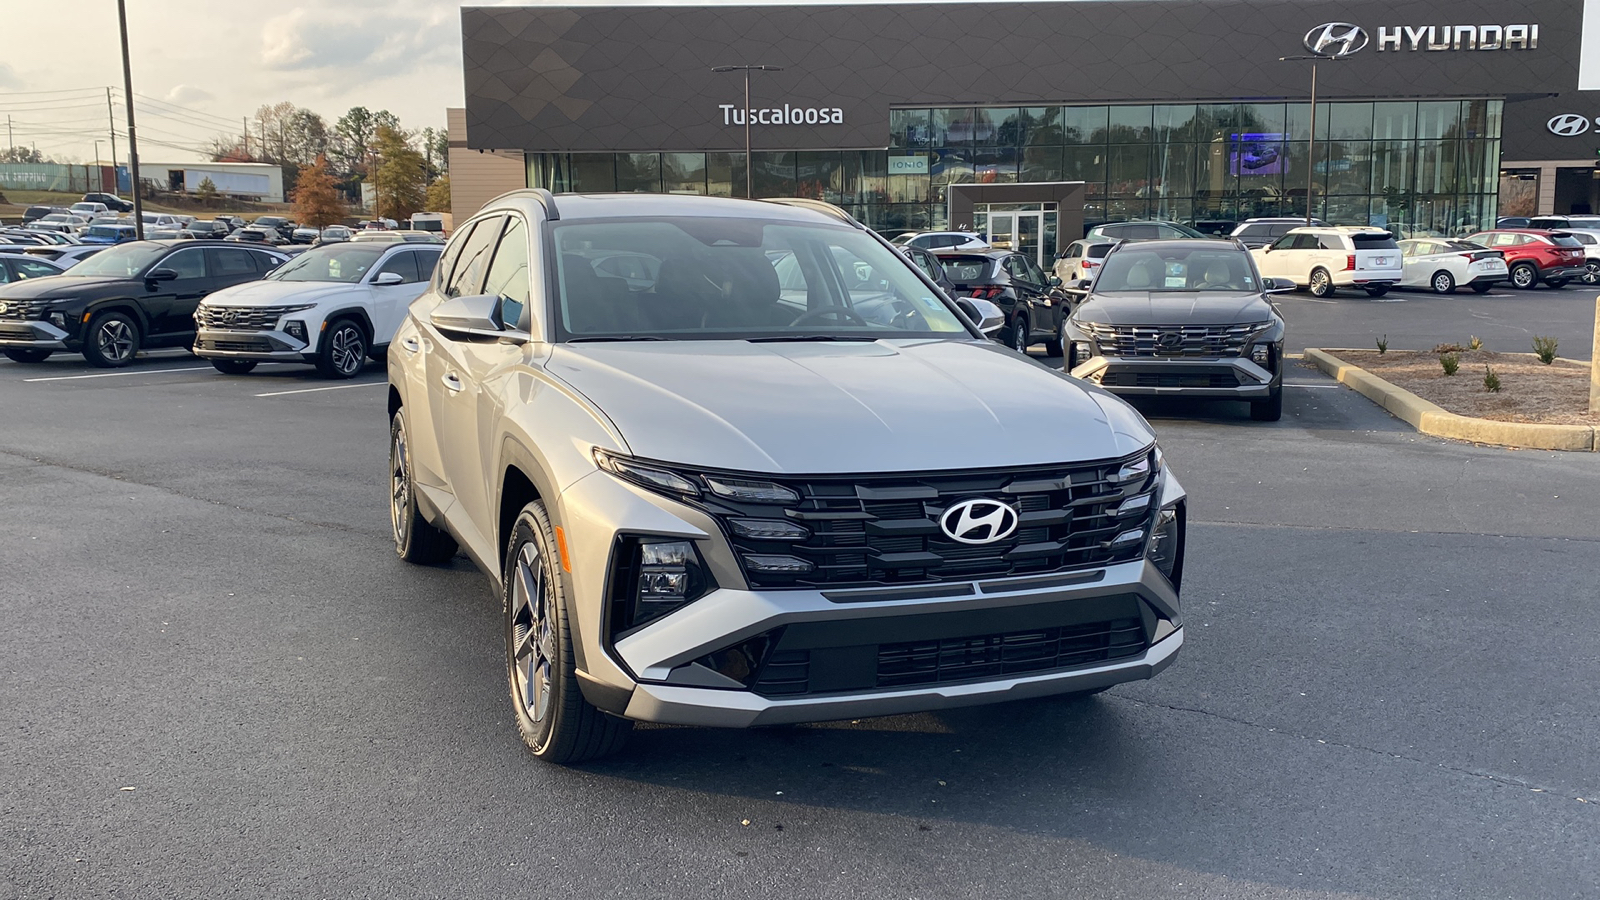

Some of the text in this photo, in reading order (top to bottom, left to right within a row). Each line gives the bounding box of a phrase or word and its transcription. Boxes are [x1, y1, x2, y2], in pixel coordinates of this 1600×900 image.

[1377, 24, 1539, 51] HYUNDAI
[718, 103, 843, 125] Tuscaloosa
[13, 172, 47, 182] SHIPPING
